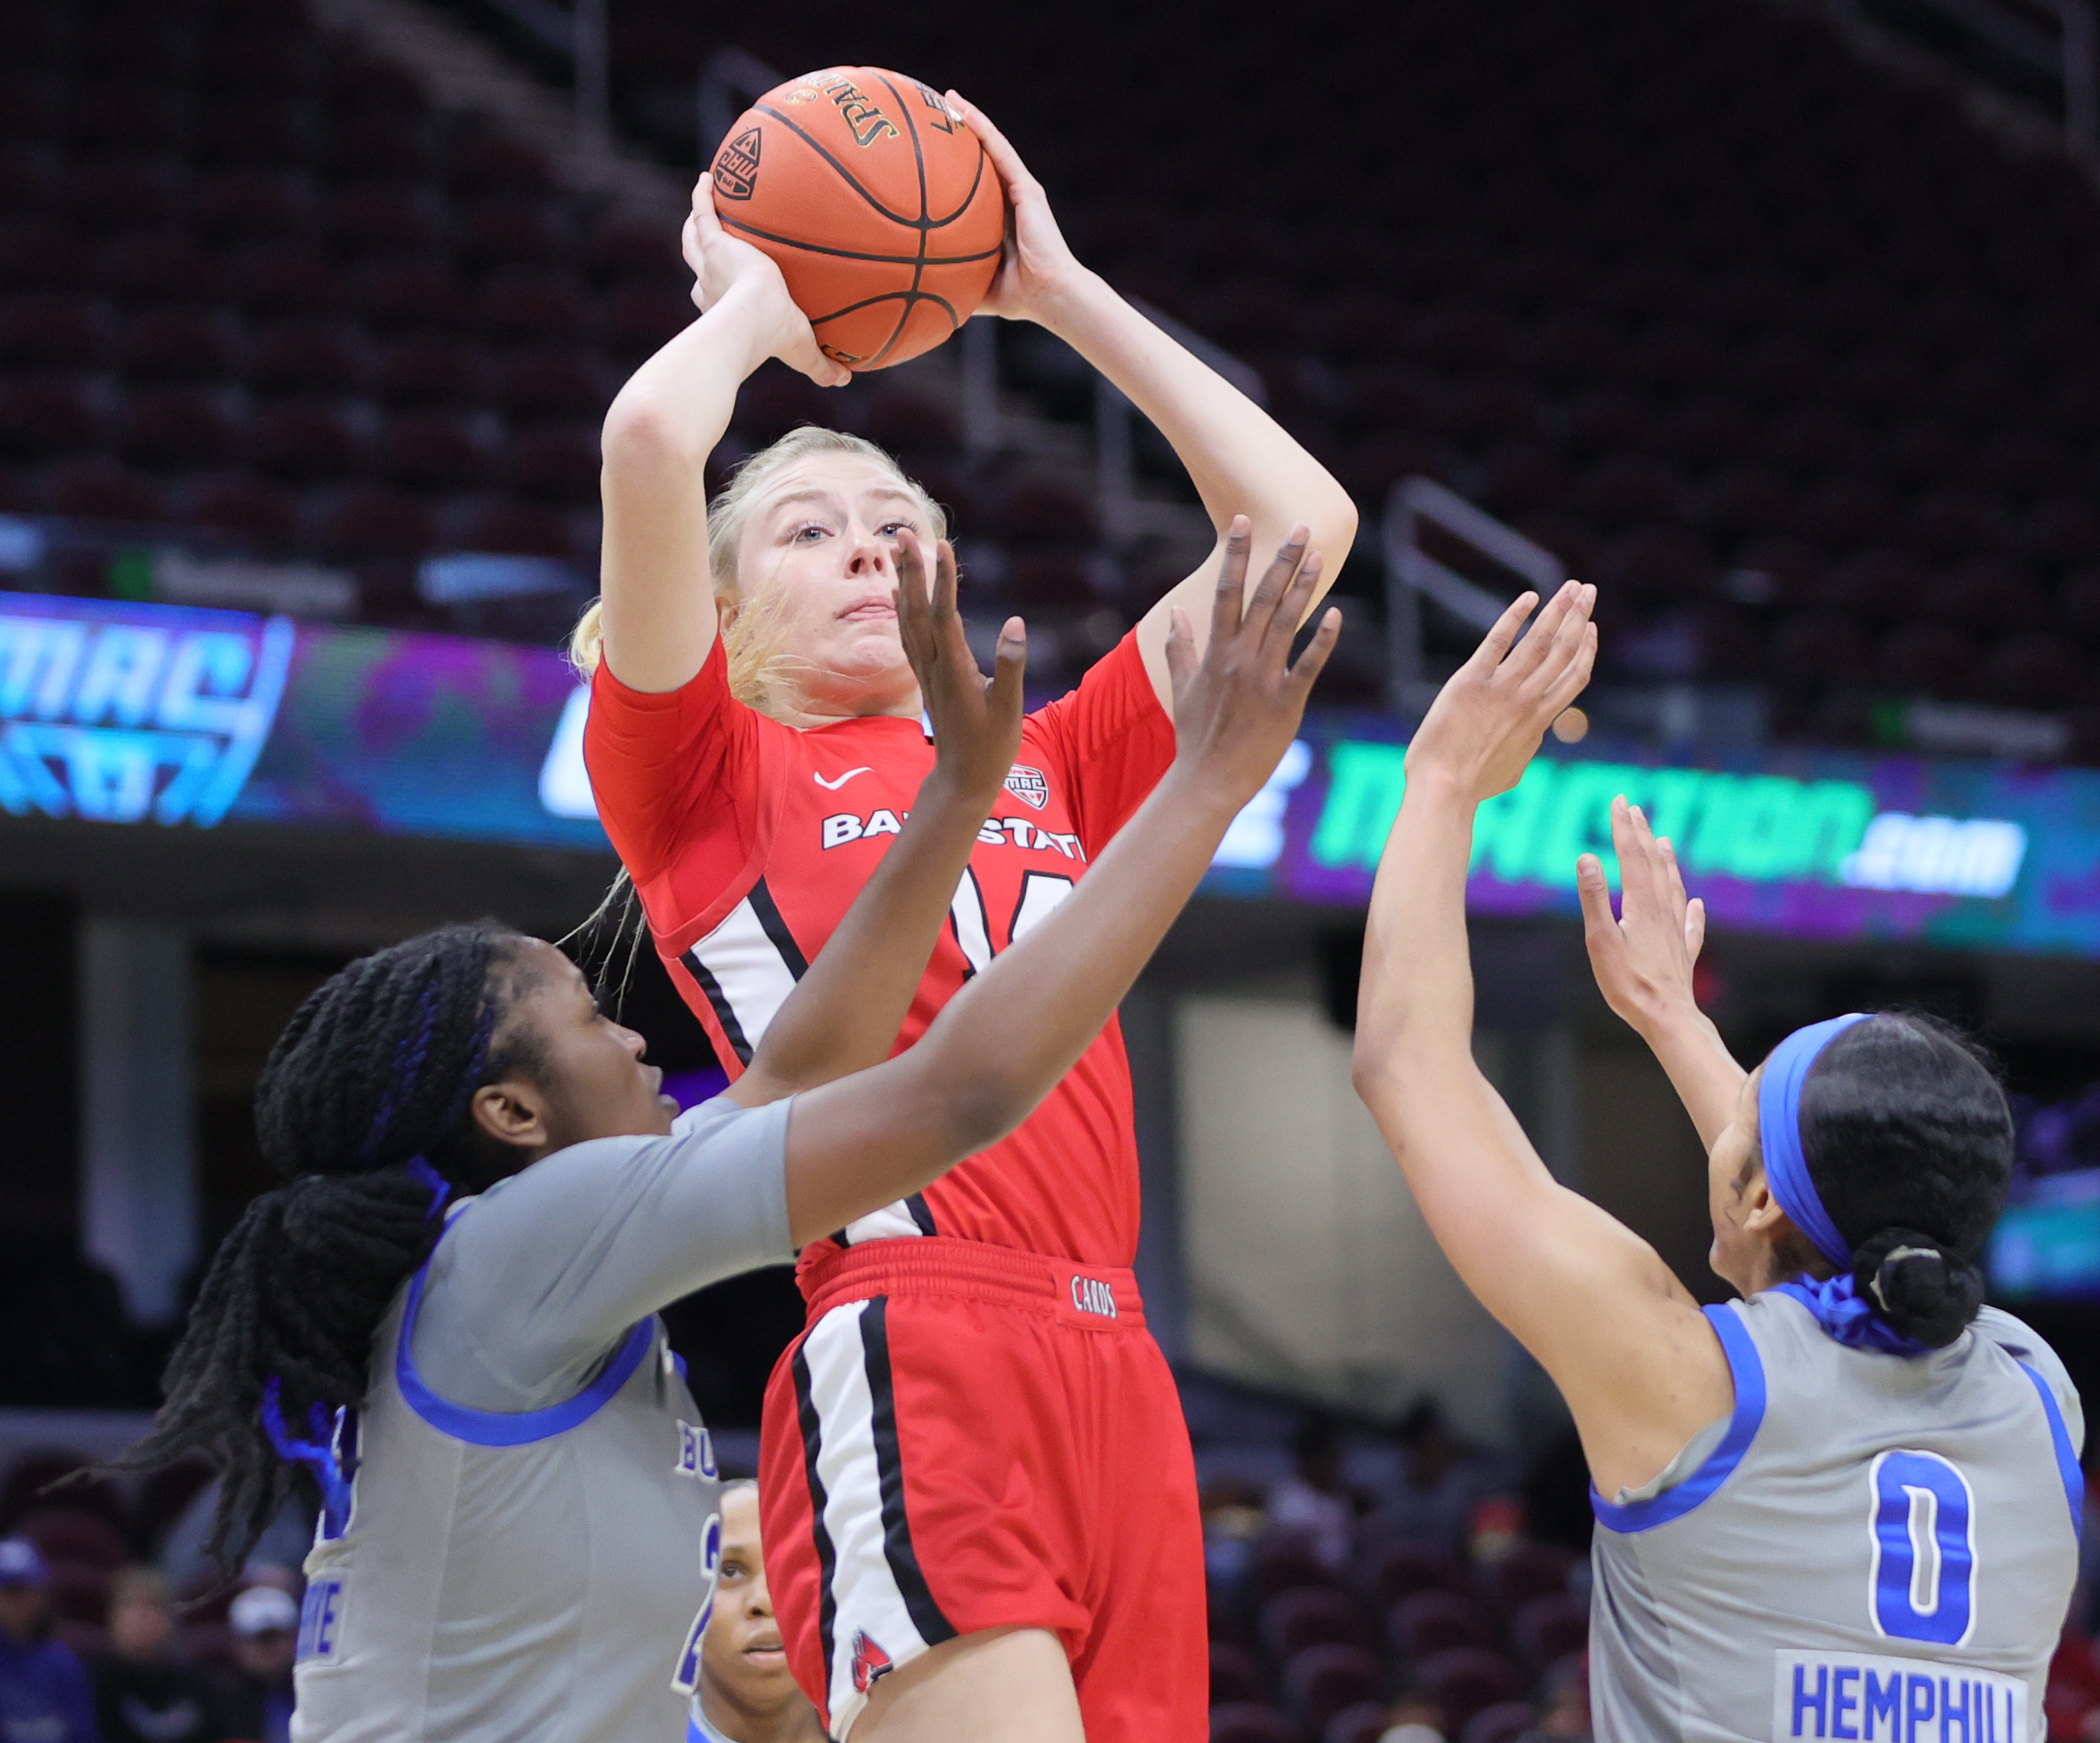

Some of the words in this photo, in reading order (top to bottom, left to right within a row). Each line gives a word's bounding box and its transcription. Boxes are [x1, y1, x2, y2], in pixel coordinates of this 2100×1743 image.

[1004, 777, 1047, 791] MAC
[822, 809, 912, 850] BA
[1071, 1274, 1118, 1319] CARDS
[1869, 1449, 1979, 1650] 0
